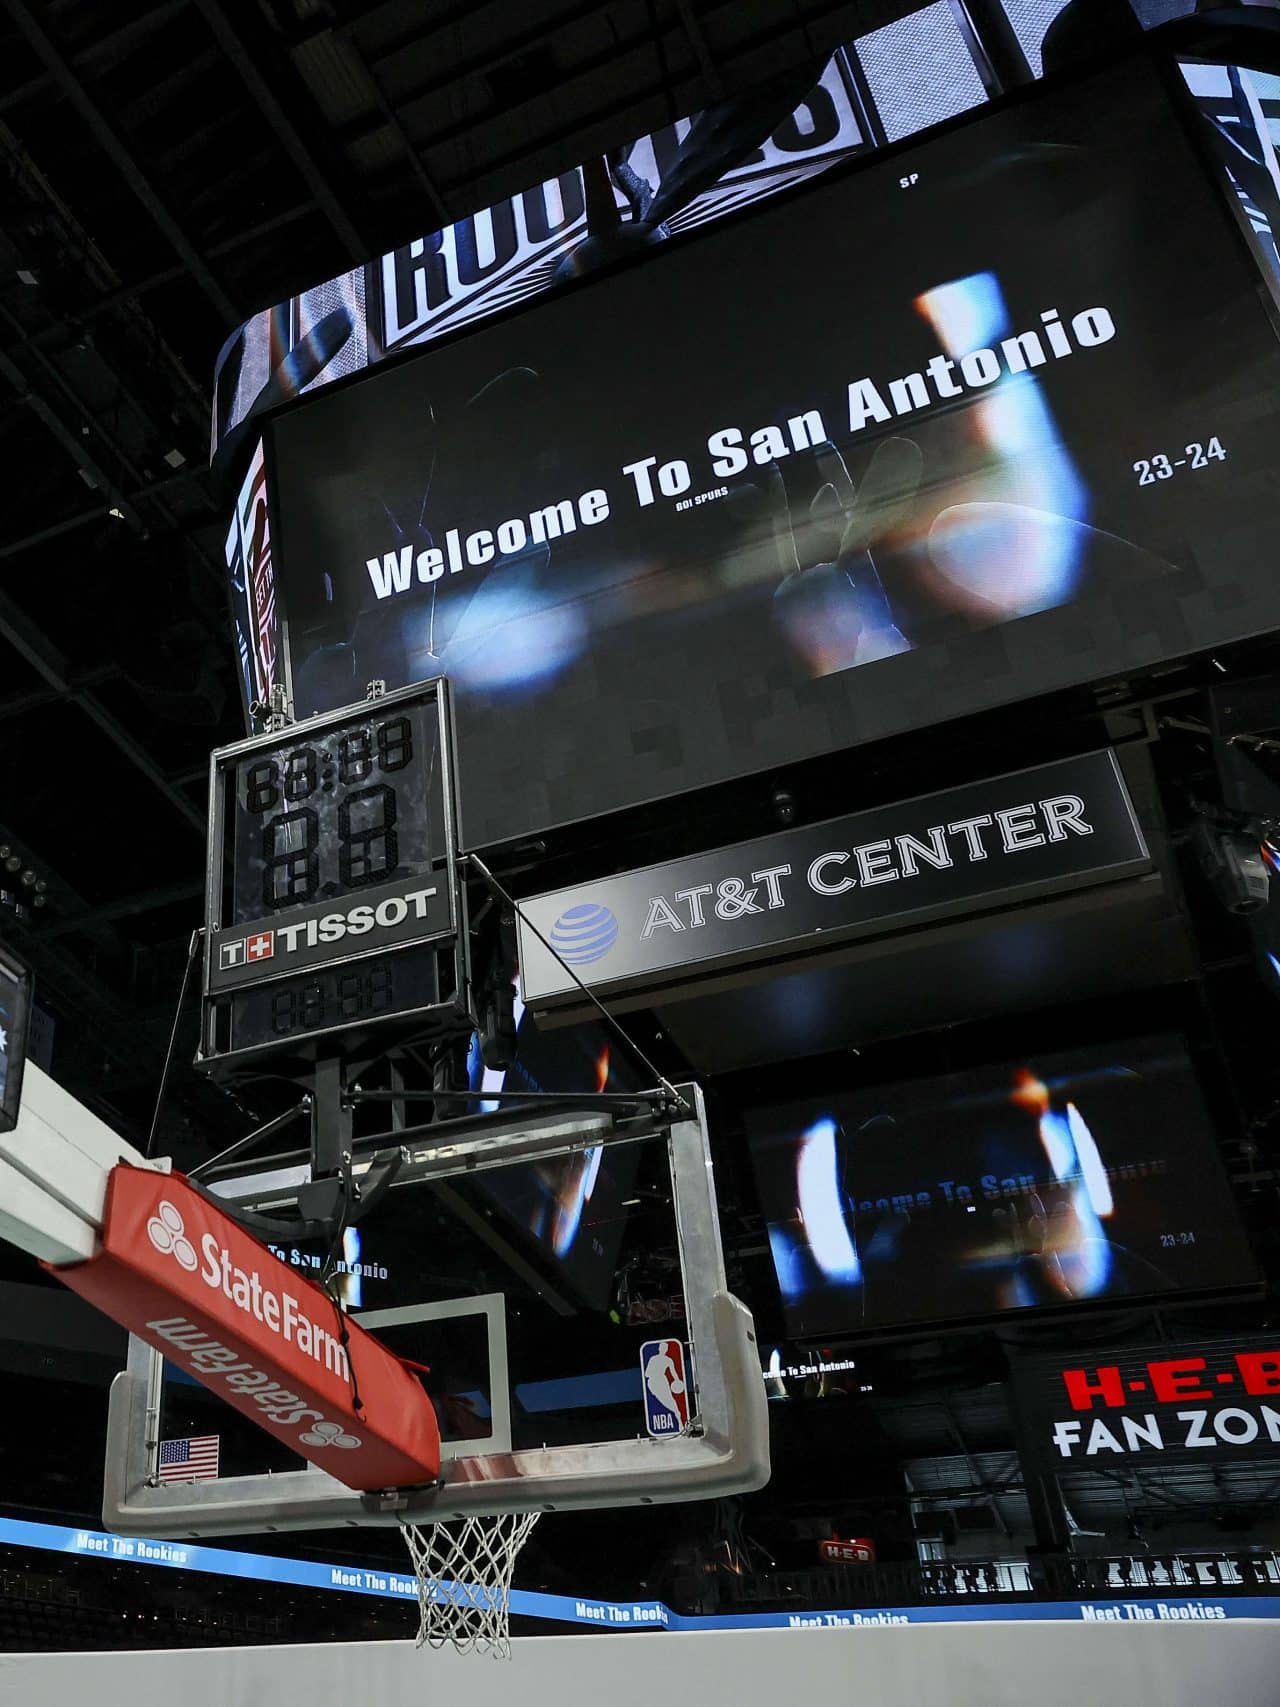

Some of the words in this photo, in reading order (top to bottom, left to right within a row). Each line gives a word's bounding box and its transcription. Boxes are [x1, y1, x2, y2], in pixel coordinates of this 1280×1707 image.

[899, 173, 919, 188] SP
[365, 487, 610, 600] Welcome
[622, 456, 691, 507] To
[707, 408, 827, 478] San
[847, 306, 1117, 433] Antonio
[1132, 436, 1227, 486] 23-24
[694, 486, 729, 505] SPURS
[639, 863, 792, 942] AT&T
[807, 793, 1093, 897] CENTER
[277, 887, 437, 953] TISSOT
[336, 1259, 388, 1280] ntonio
[799, 1364, 818, 1375] San
[819, 1360, 855, 1373] Antonio
[652, 1413, 674, 1431] NBA
[1052, 1413, 1165, 1458] FAN
[76, 1534, 109, 1552] Meet
[111, 1538, 134, 1556] The
[136, 1541, 187, 1564] Rookies
[331, 1568, 362, 1587] Meet
[364, 1573, 386, 1590] The
[575, 1602, 606, 1620] Meet
[607, 1606, 631, 1622] The
[1080, 1605, 1122, 1621] Meet
[1122, 1603, 1154, 1620] The
[1157, 1602, 1226, 1620] Rookies
